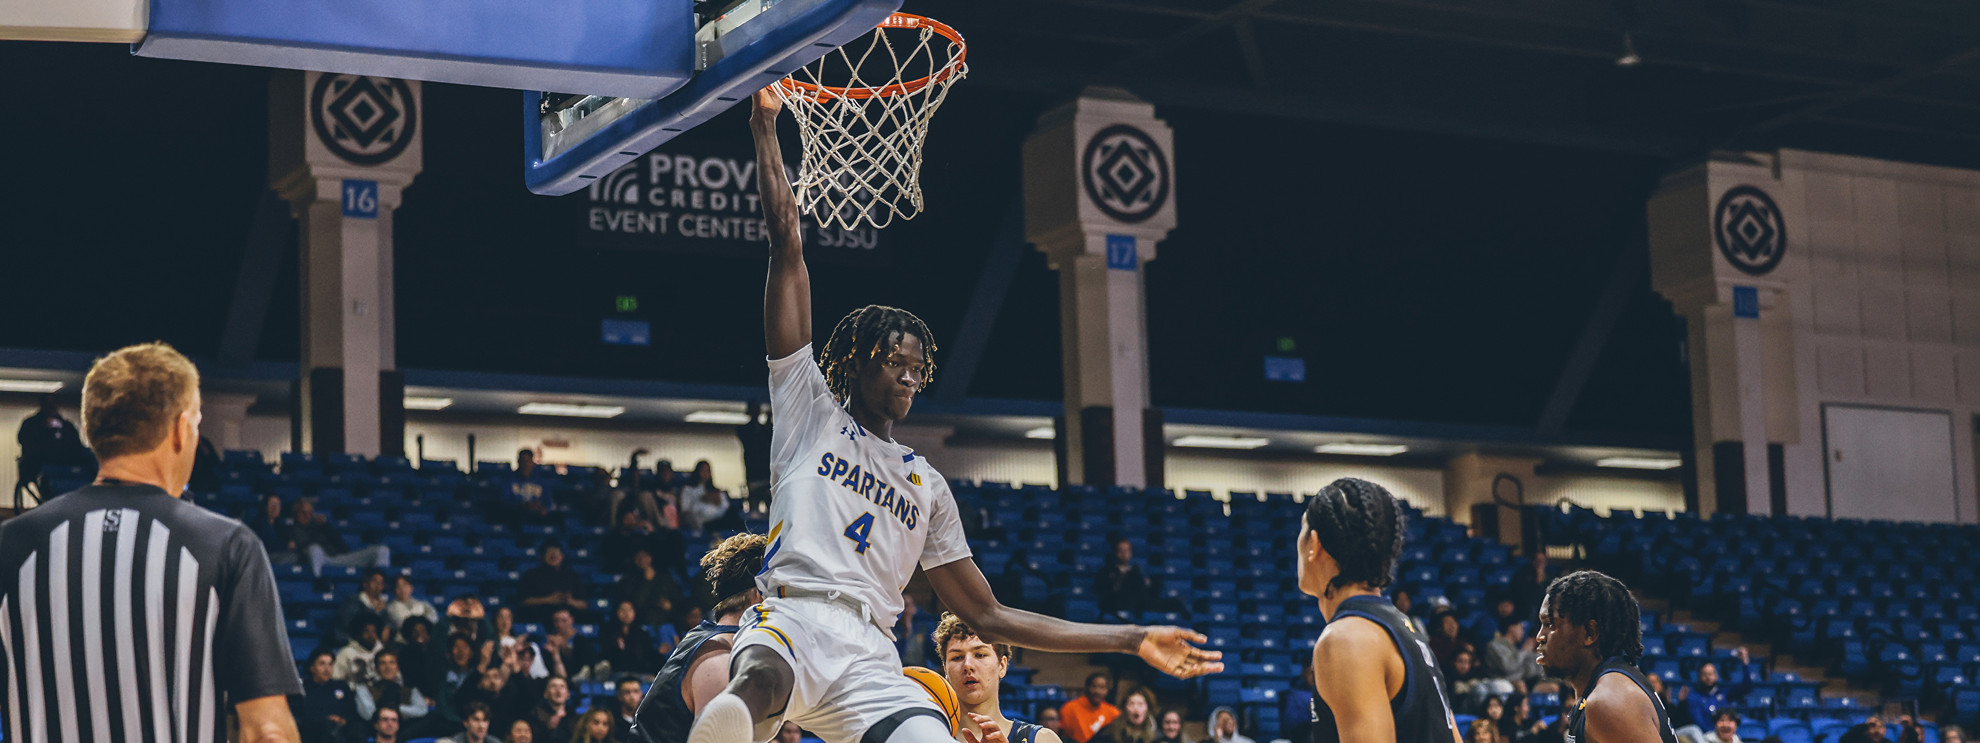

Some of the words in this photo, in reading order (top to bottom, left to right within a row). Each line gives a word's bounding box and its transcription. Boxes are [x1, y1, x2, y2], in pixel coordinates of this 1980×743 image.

[346, 187, 375, 212] 16
[647, 188, 760, 213] CREDIT
[589, 208, 668, 235] EVENT
[817, 226, 878, 250] SJSU
[1111, 242, 1133, 265] 17
[817, 451, 920, 531] SPARTANS
[843, 510, 875, 556] 4
